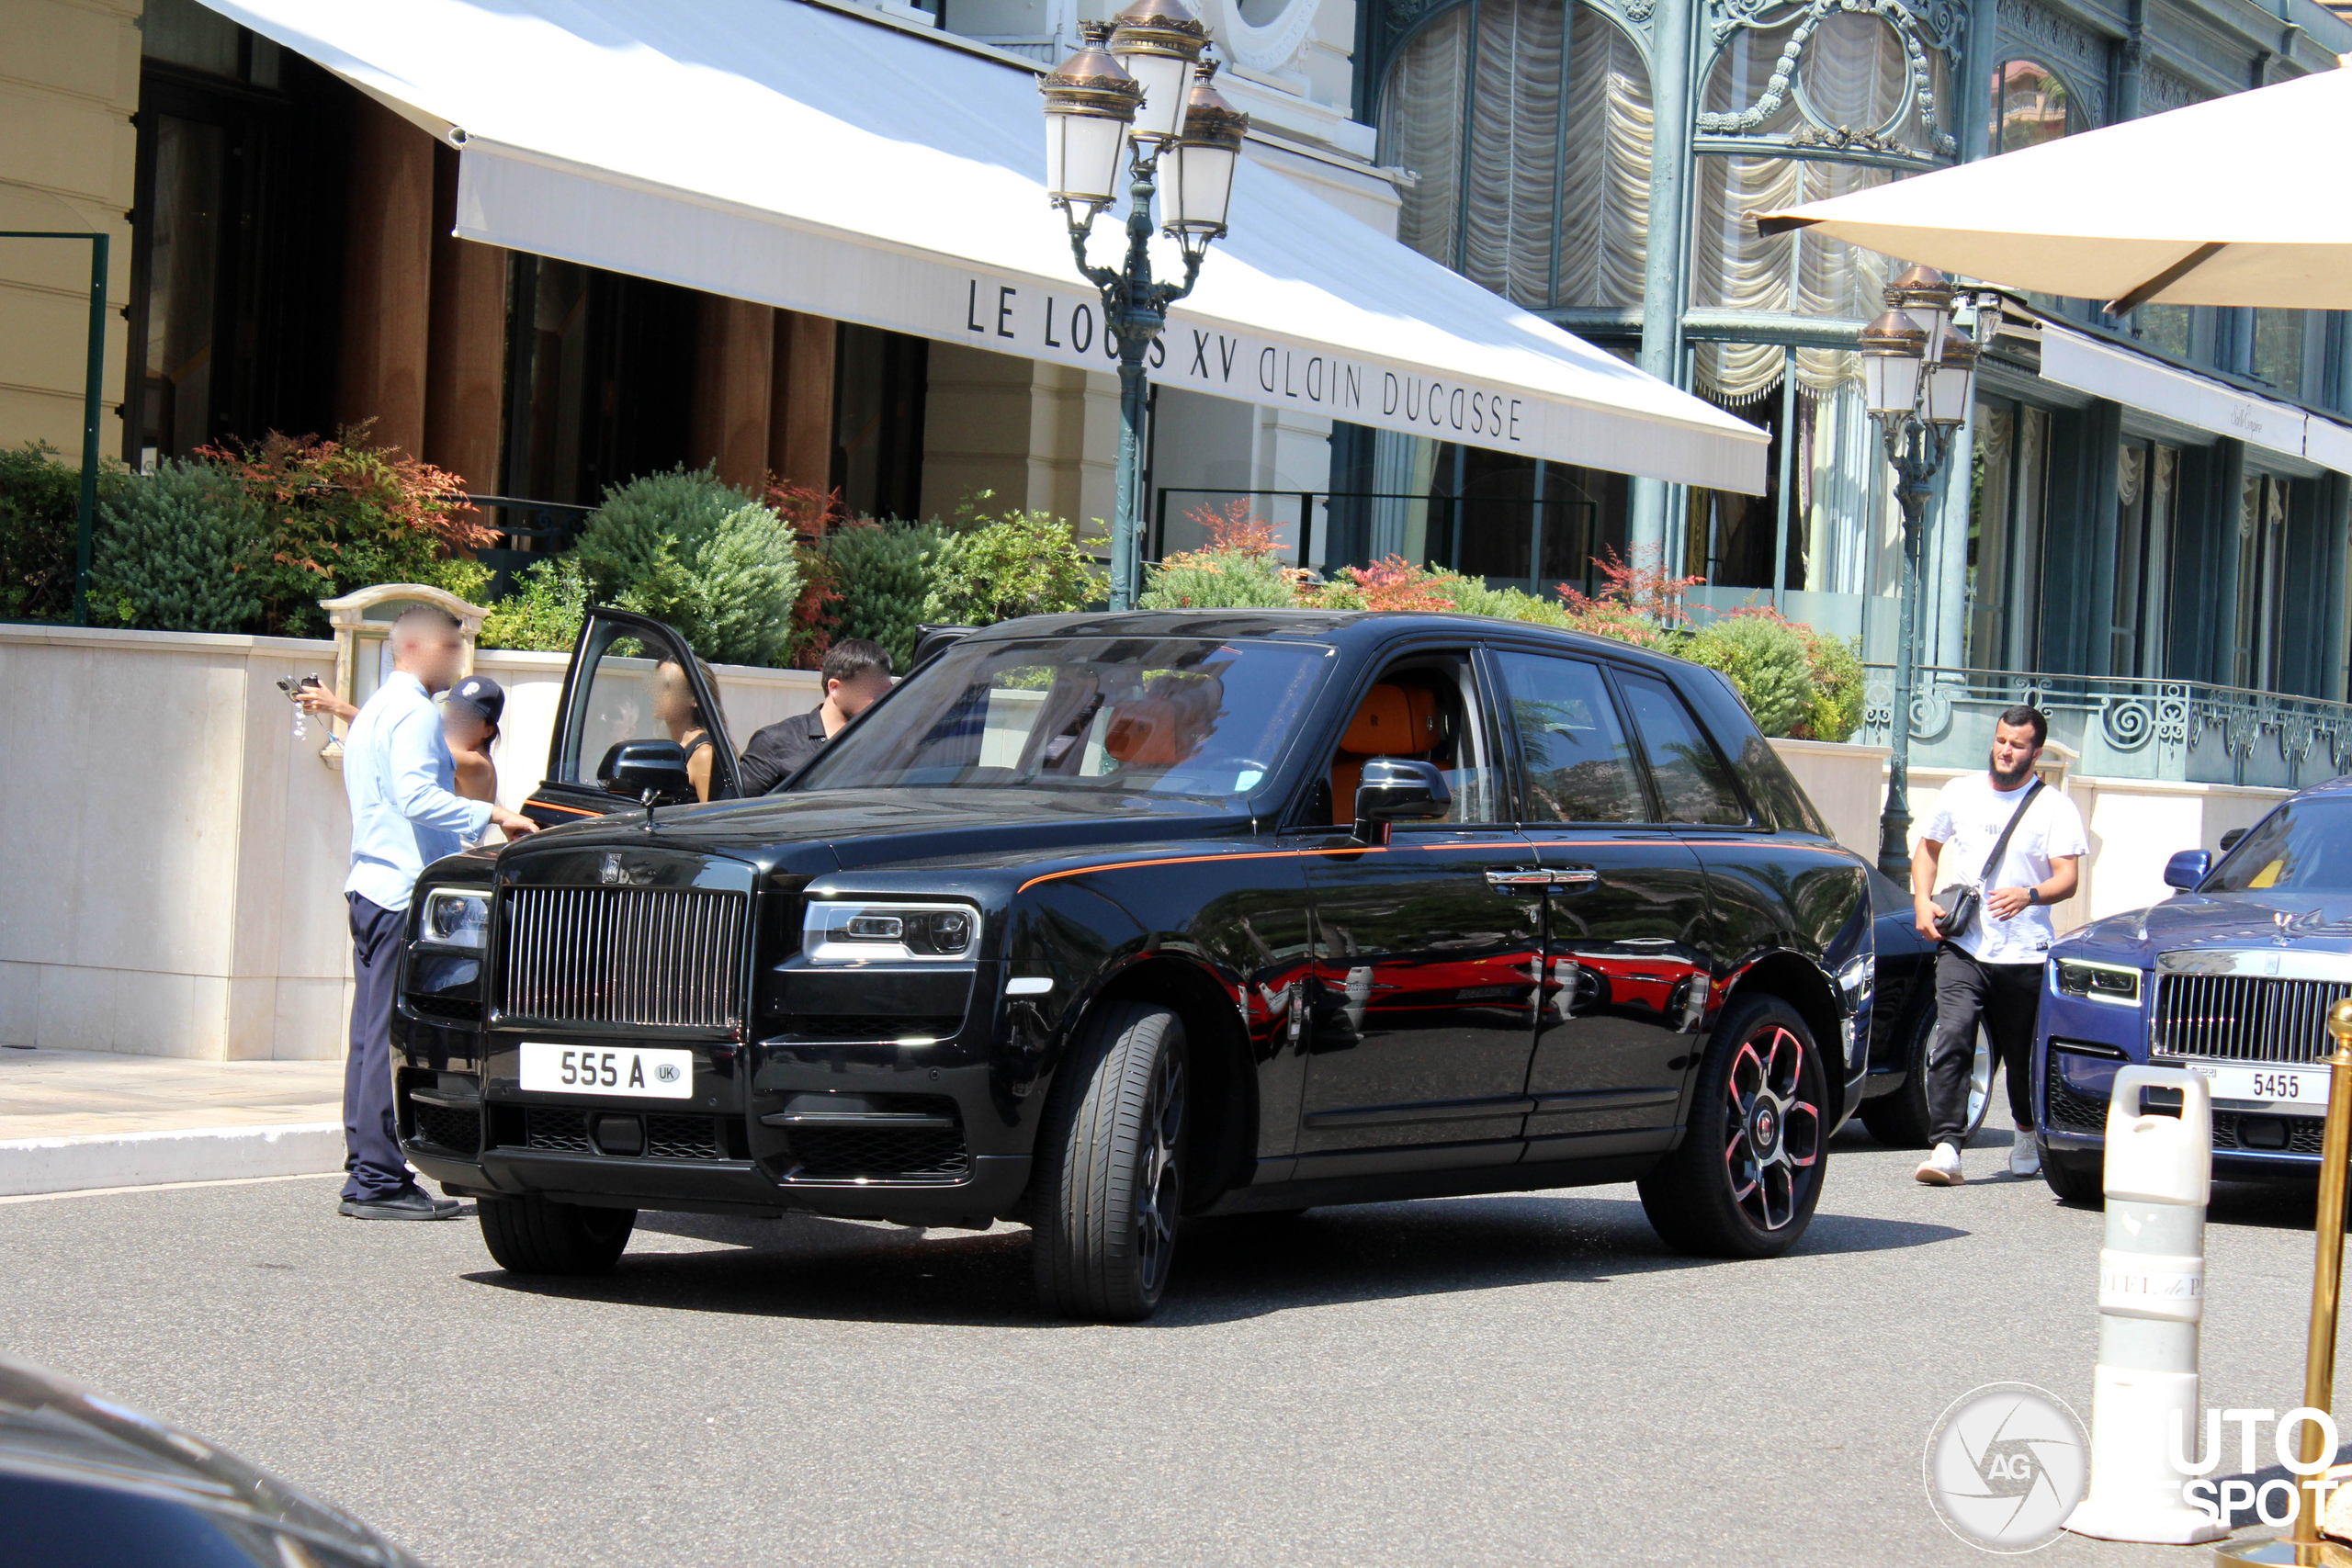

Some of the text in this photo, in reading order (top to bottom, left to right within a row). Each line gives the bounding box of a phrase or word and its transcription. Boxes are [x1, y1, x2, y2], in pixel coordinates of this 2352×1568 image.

[967, 279, 1016, 339] LE
[1045, 296, 1166, 369] LOS
[1190, 329, 1237, 383] XV
[560, 1051, 646, 1089] 555 A
[659, 1066, 674, 1079] UK
[2254, 1073, 2300, 1098] 5455
